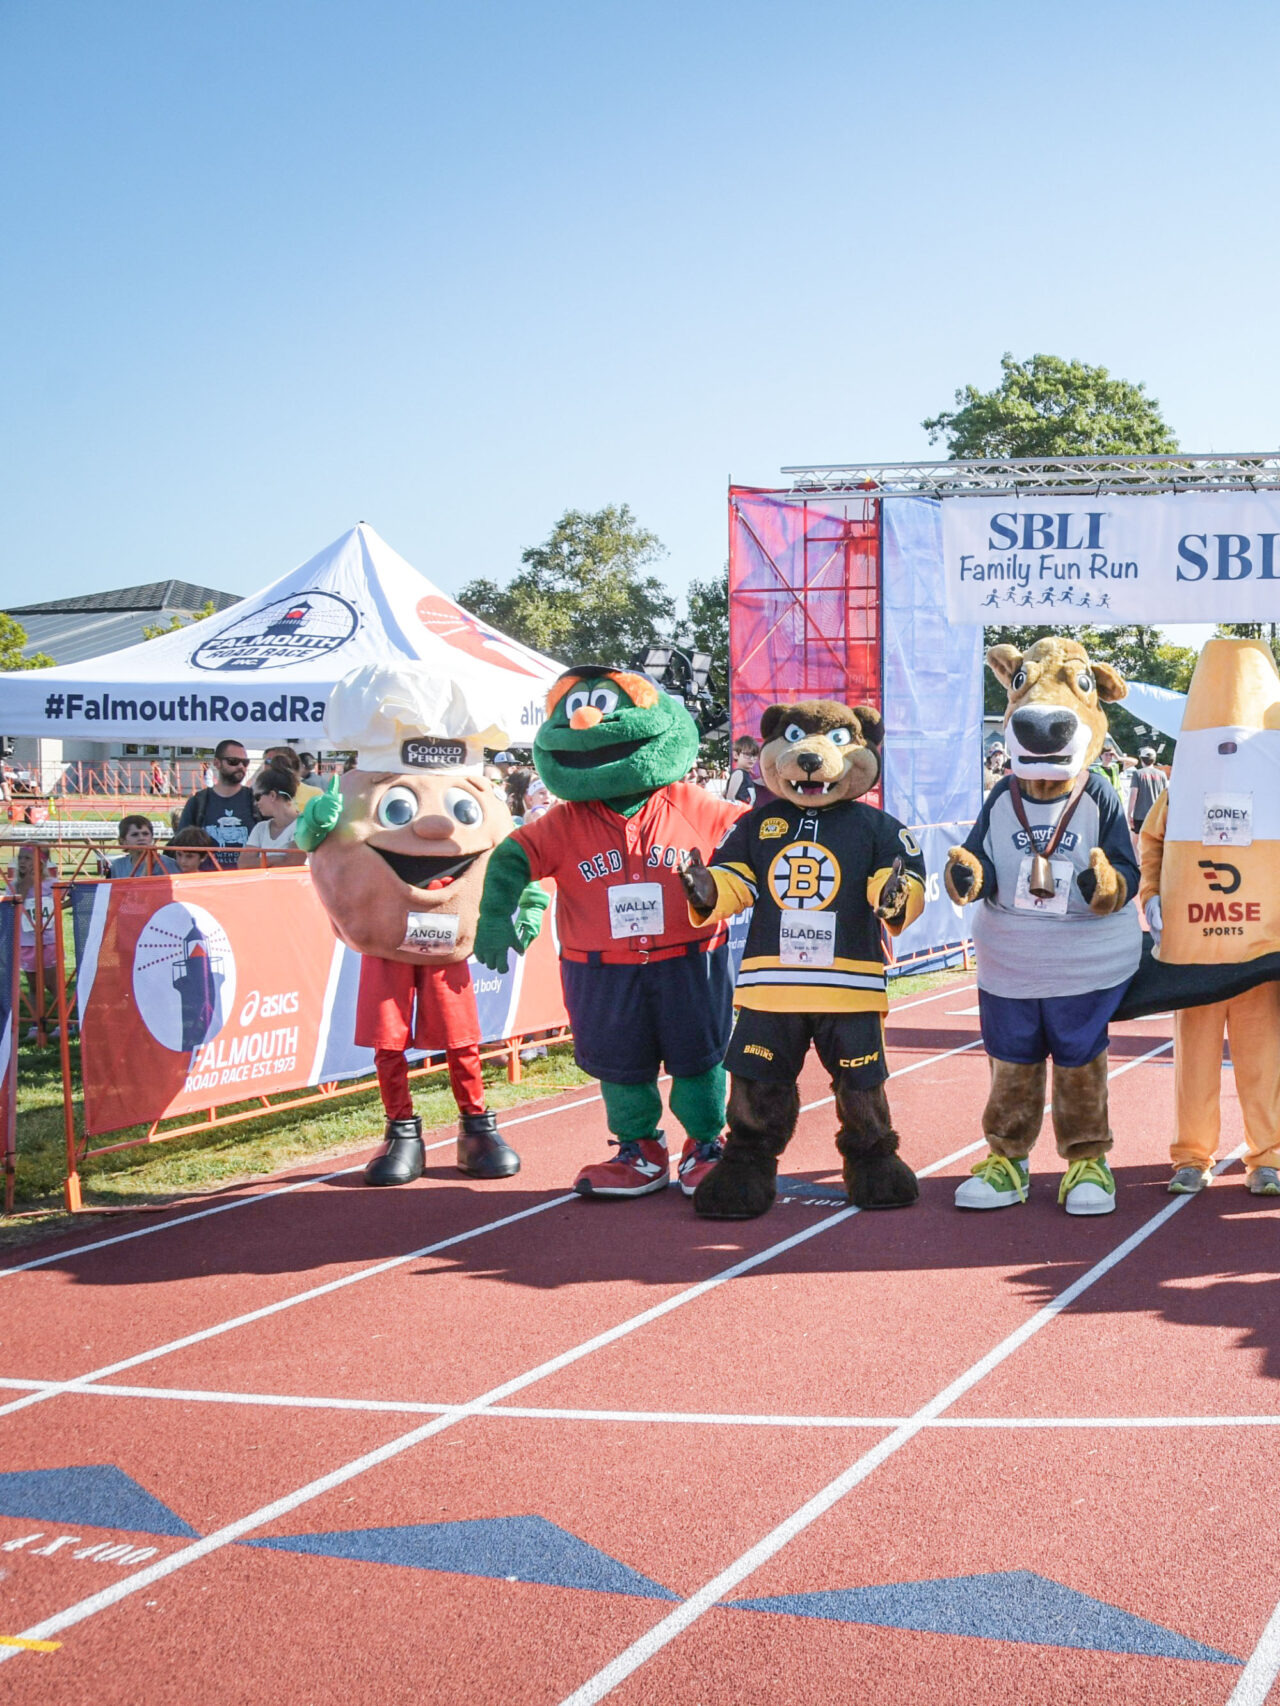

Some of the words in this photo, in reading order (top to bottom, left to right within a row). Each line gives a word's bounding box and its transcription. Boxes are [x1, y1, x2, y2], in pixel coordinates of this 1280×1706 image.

[988, 512, 1107, 551] SBLI
[960, 553, 1031, 588] Family
[1039, 554, 1081, 580] Fun
[1089, 552, 1138, 580] Run
[203, 634, 341, 650] FALMOUTH
[205, 648, 259, 659] ROAD
[261, 647, 314, 658] RACE
[44, 693, 326, 722] #FalmouthRoadRa
[407, 743, 462, 755] COOKED
[408, 753, 462, 765] PERFECT
[1207, 809, 1248, 820] CONEY
[578, 849, 623, 882] RED
[787, 856, 822, 898] B
[615, 900, 657, 914] WALLY
[1188, 902, 1261, 923] DMSE
[410, 929, 452, 940] ANGUS
[782, 928, 833, 940] BLADES
[1202, 927, 1244, 937] SPORTS
[481, 976, 502, 994] body
[260, 992, 299, 1018] asics
[187, 1026, 299, 1074] FALMOUTH
[743, 1045, 774, 1061] BRUINS
[840, 1051, 879, 1067] CCM
[184, 1071, 218, 1093] ROAD
[220, 1064, 250, 1085] RACE
[72, 1541, 160, 1565] 400
